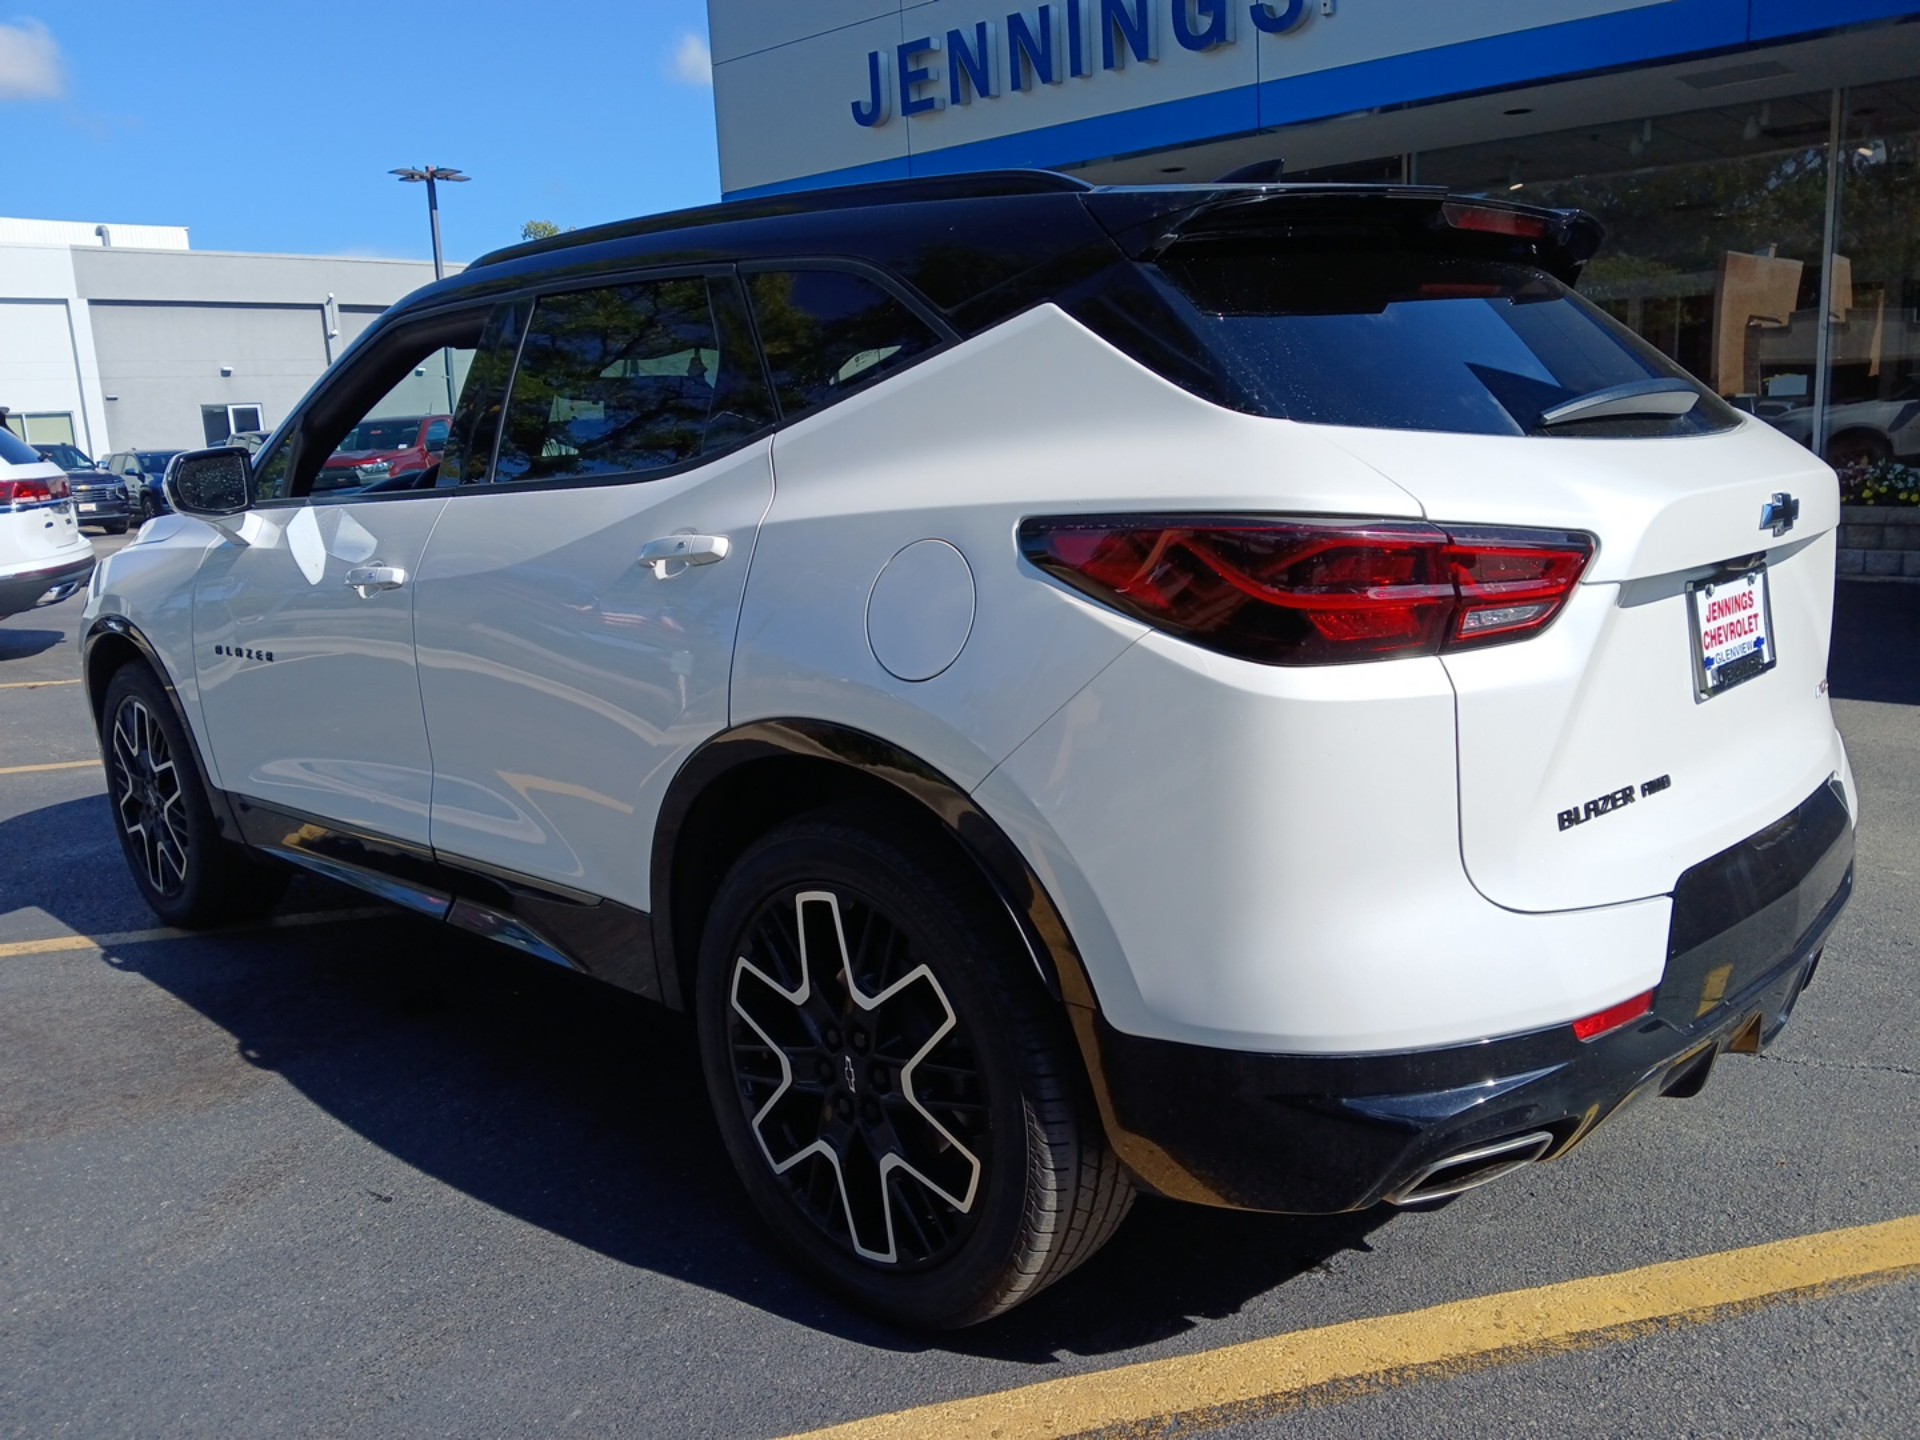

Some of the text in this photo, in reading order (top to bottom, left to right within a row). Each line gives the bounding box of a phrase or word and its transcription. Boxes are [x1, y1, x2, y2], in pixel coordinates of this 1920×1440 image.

[1705, 590, 1754, 624] JENNINGS
[1703, 613, 1760, 651] CHEVROLET
[215, 645, 274, 662] BLAZER
[1715, 640, 1754, 664] GLENVIEW
[1557, 774, 1672, 832] BLAZER AWD
